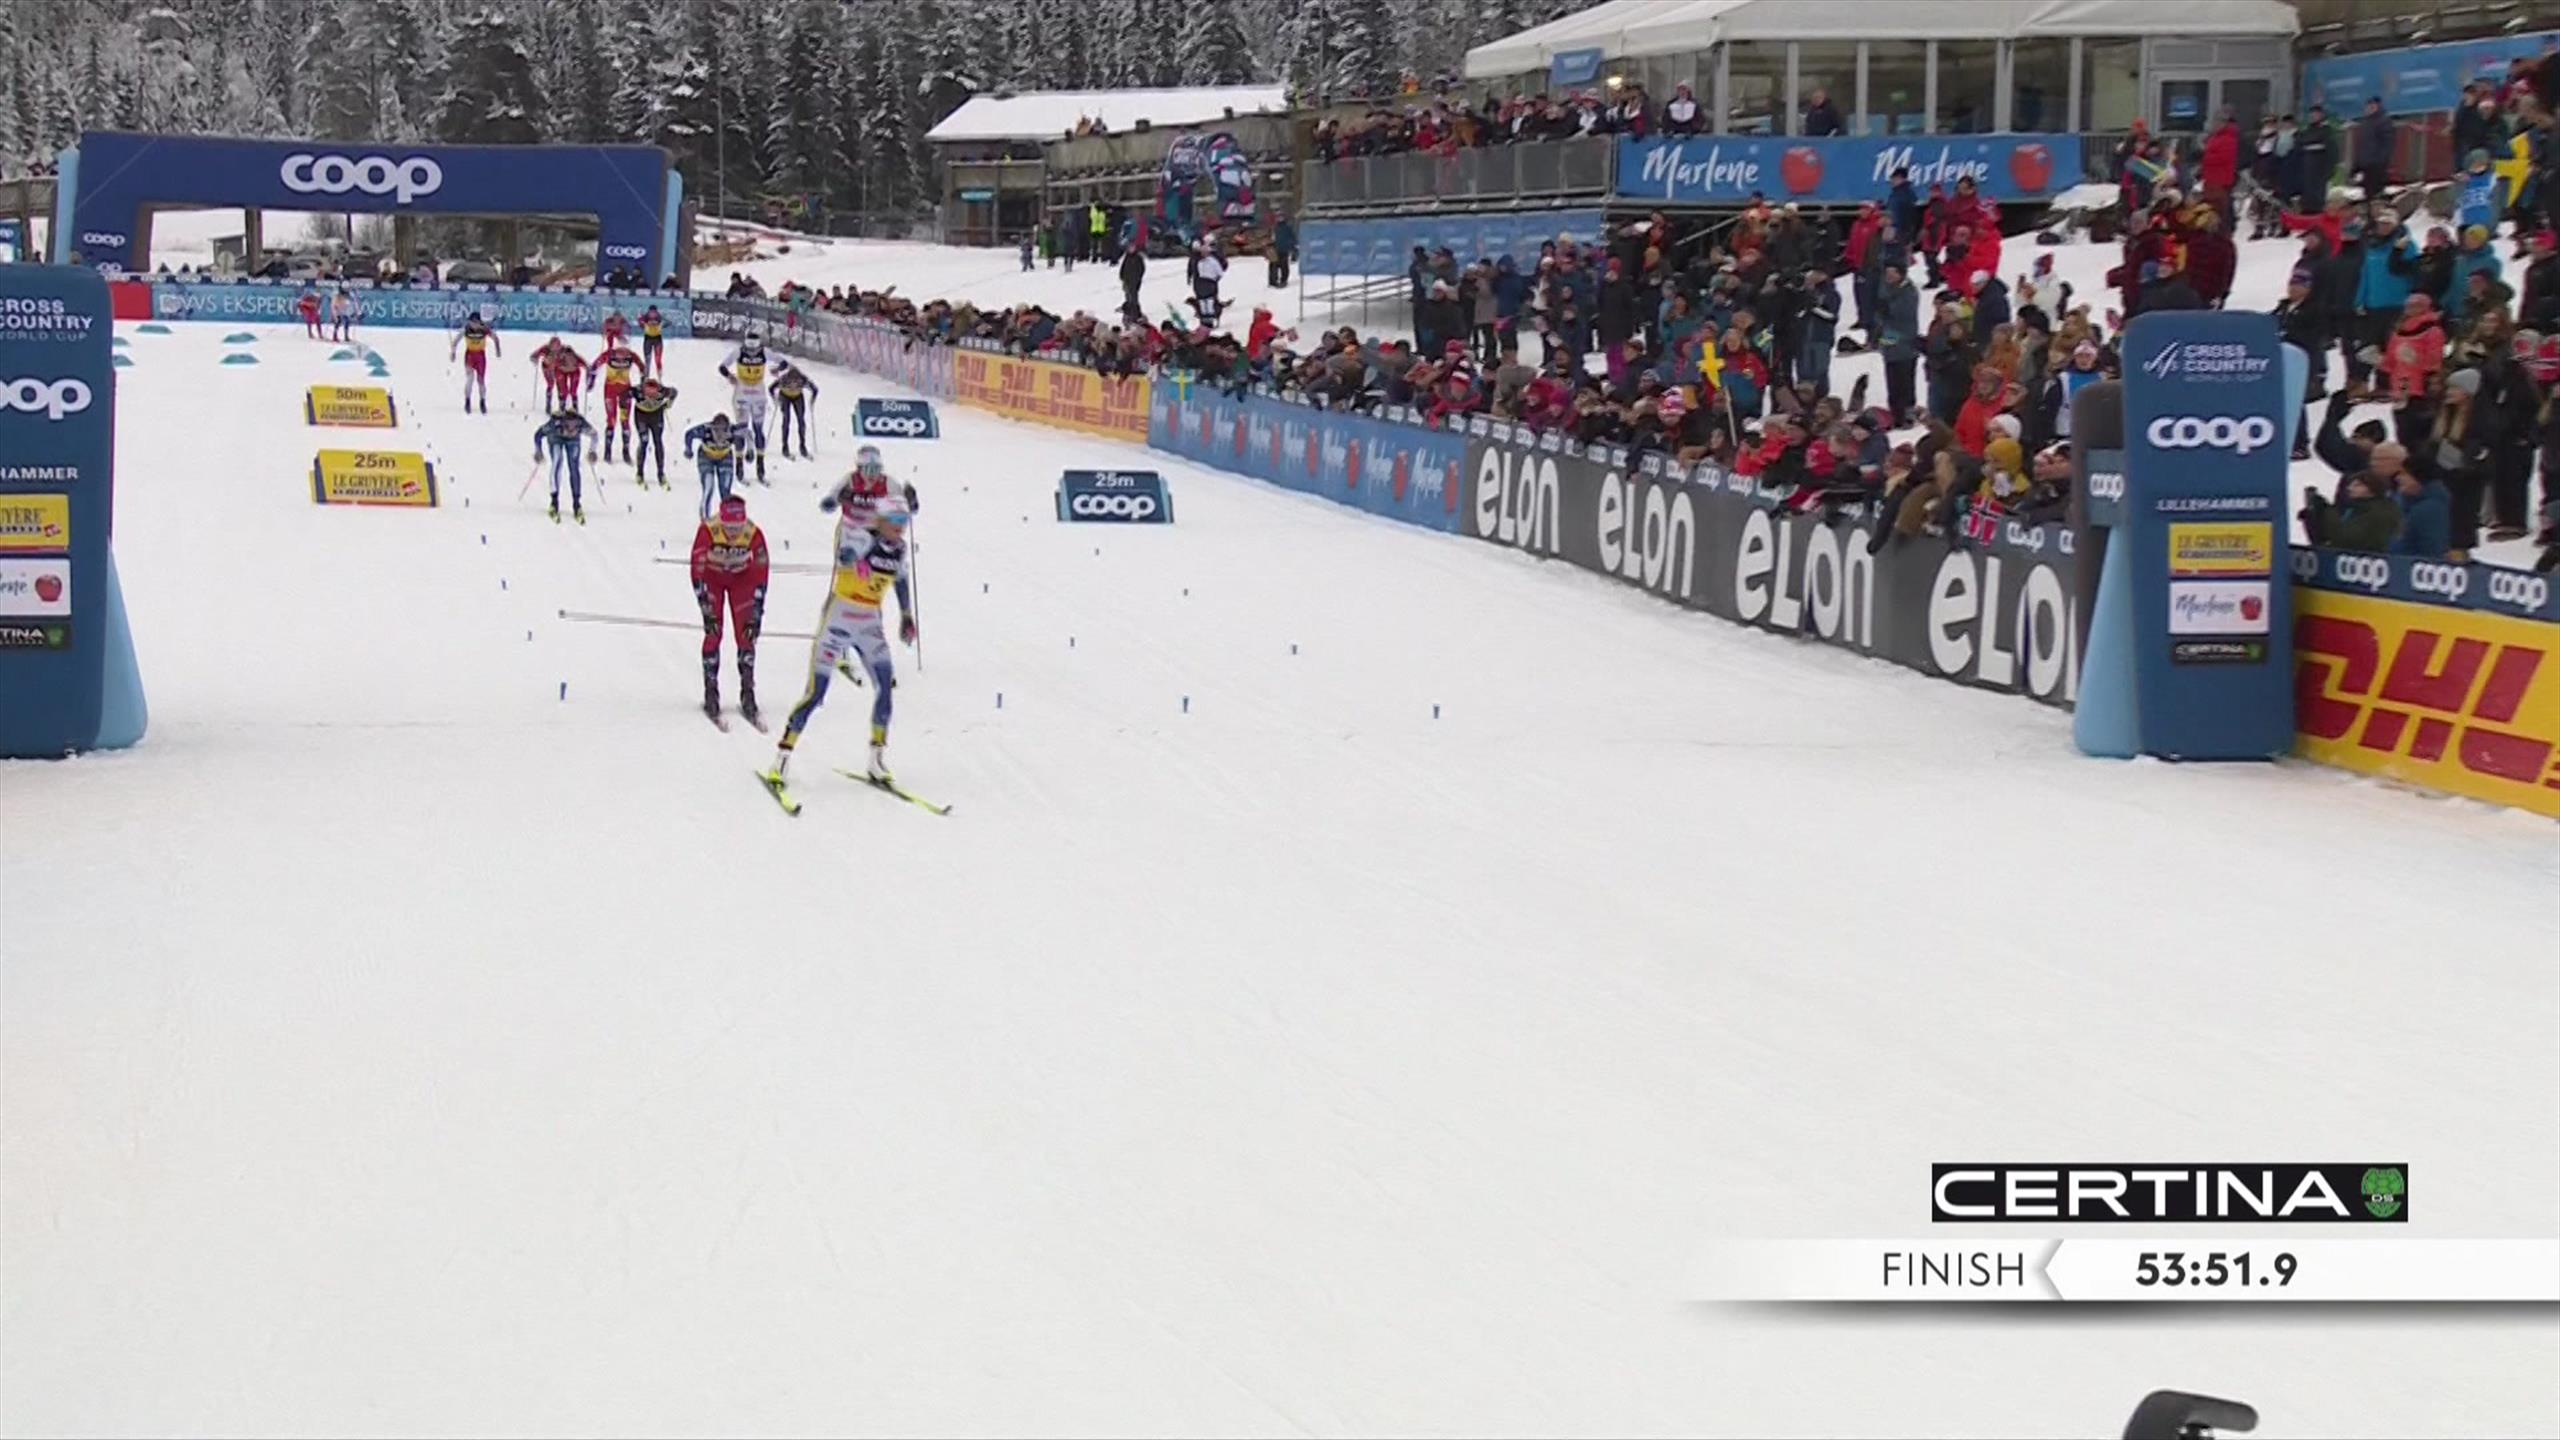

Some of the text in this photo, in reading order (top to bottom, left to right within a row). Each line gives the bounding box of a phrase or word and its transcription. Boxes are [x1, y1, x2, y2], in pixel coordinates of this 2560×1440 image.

[1642, 145, 1758, 199] Marlene
[1873, 145, 1988, 186] Marlene
[281, 154, 442, 203] coop
[83, 232, 125, 247] coop
[605, 246, 646, 259] coop
[0, 299, 64, 314] ROSS
[224, 296, 300, 314] EKSPERT
[2183, 344, 2246, 358] CROSS
[2183, 359, 2269, 372] COUNTRY
[0, 378, 92, 419] op
[865, 416, 926, 436] coop
[2147, 416, 2275, 455] coop
[354, 452, 396, 468] 25m
[1095, 472, 1134, 487] 25m
[1073, 494, 1155, 519] coop
[2336, 555, 2389, 591] coop
[2411, 562, 2468, 601] coop
[2490, 571, 2547, 612] coop
[2294, 615, 2553, 784] DHL
